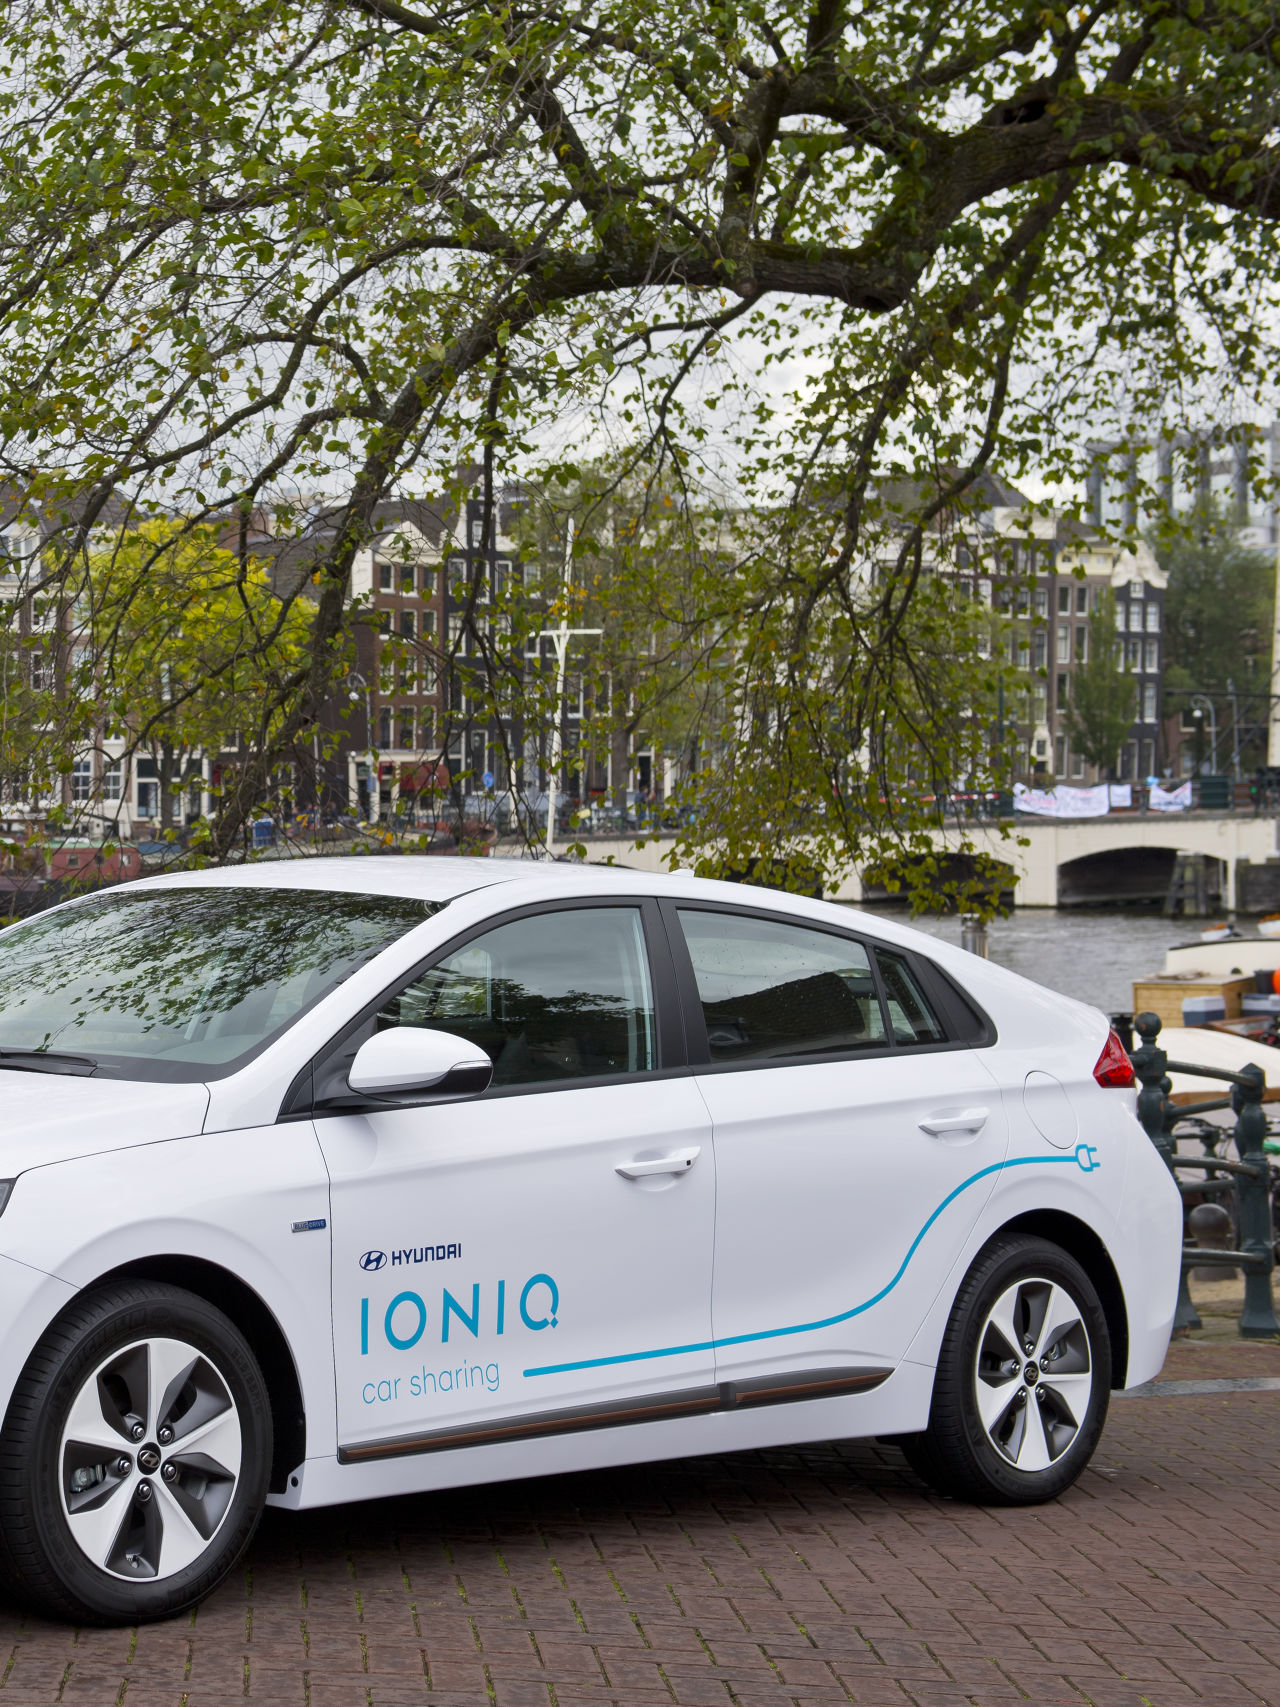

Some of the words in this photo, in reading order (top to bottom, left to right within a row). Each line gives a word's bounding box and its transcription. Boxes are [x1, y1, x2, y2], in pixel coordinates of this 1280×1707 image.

[392, 1243, 462, 1266] HYUNDAI
[361, 1273, 559, 1355] IONIQ
[362, 1378, 400, 1404] car
[410, 1360, 499, 1396] sharing
